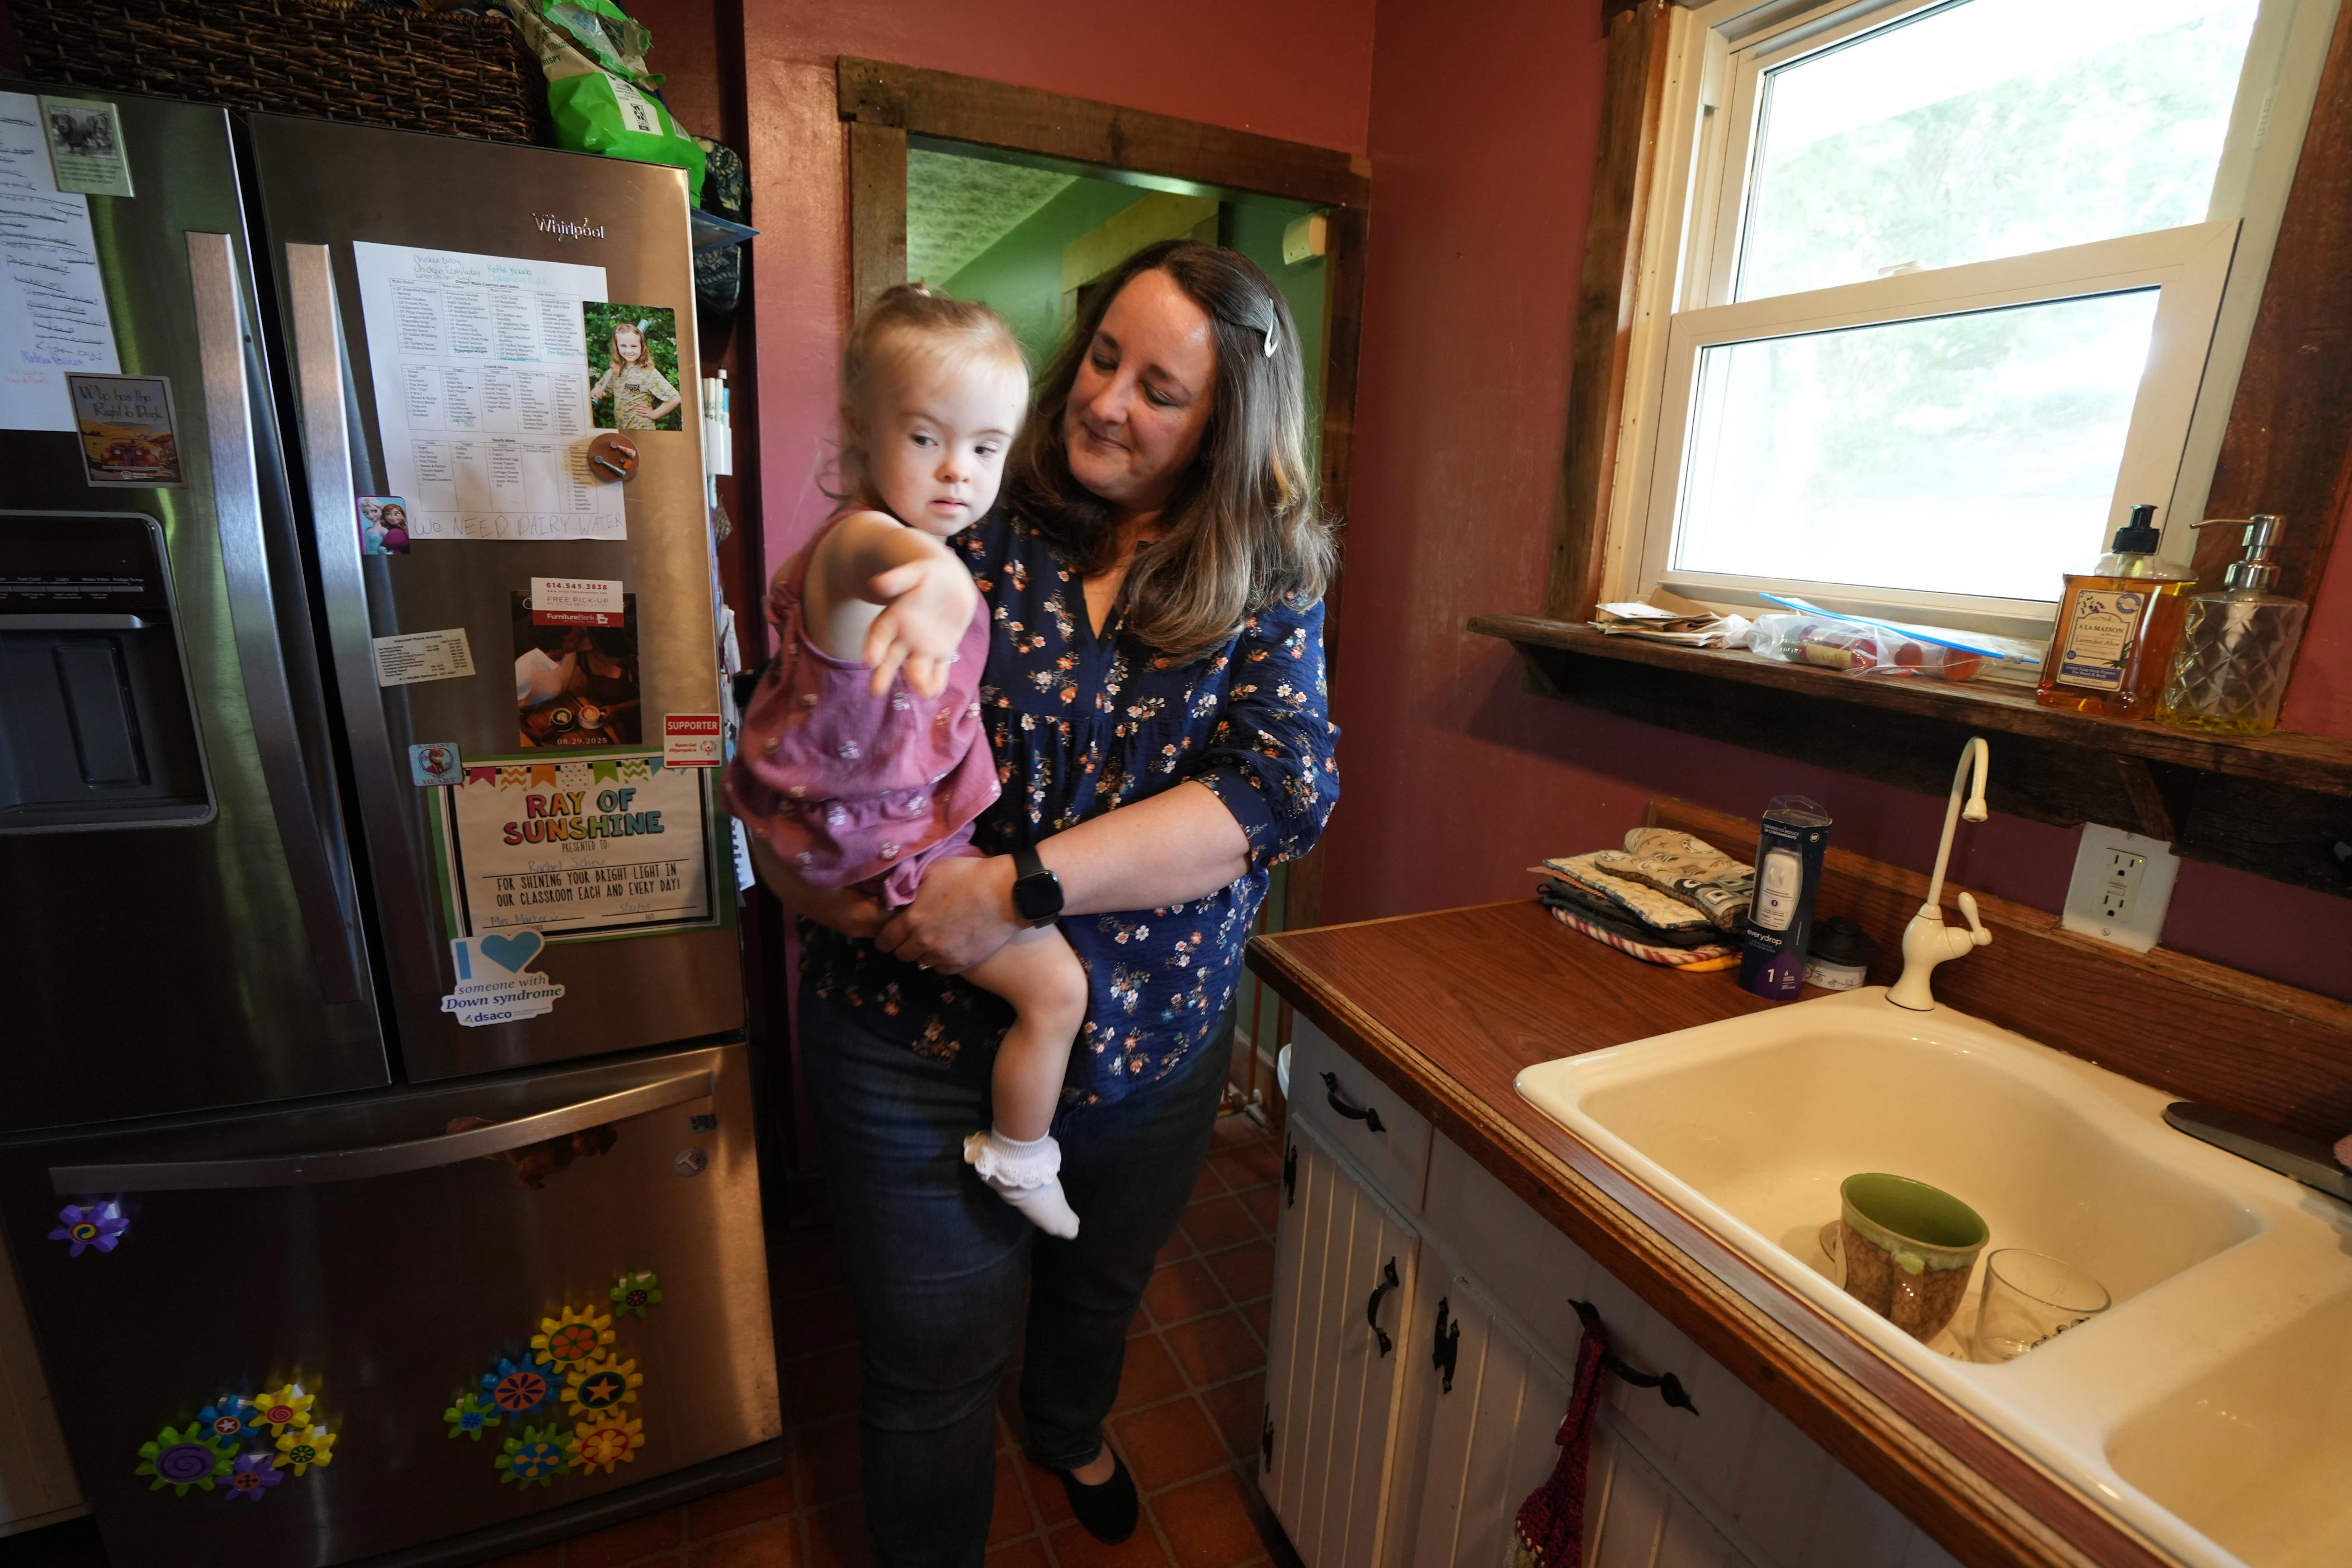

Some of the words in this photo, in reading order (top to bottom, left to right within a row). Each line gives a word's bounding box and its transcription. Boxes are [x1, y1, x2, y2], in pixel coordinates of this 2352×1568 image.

[541, 54, 561, 66] RISPY
[534, 214, 604, 241] Whirlpool
[414, 516, 442, 537] We
[453, 515, 508, 537] NEED
[518, 514, 570, 537] DAIRY
[578, 512, 625, 536] WATER
[2075, 636, 2103, 645] Lavender
[668, 721, 718, 730] SUPPORTER
[556, 737, 608, 745] 08.29.2025
[526, 791, 586, 819] RAY
[597, 787, 636, 813] OF
[503, 811, 664, 846] SUNSHINE
[562, 840, 596, 853] PRESENTED
[600, 839, 611, 850] TO:
[497, 877, 515, 891] FOR
[521, 873, 562, 889] SHINING
[567, 871, 591, 885] YOUR
[596, 867, 627, 882] BRIGHT
[633, 864, 660, 880] LIGHT
[666, 863, 677, 876] IN
[497, 894, 515, 907] OUR
[521, 888, 573, 905] CLASSROOM
[578, 885, 601, 900] EACH
[606, 883, 624, 898] AND
[629, 880, 654, 896] EVERY
[660, 877, 681, 892] DAY!
[1746, 928, 1783, 946] everydrop
[455, 941, 472, 980] I
[459, 981, 514, 995] someone
[519, 975, 546, 988] with
[1767, 969, 1775, 983] 1
[446, 996, 489, 1009] Down
[493, 987, 562, 1005] syndrome
[474, 1010, 512, 1022] dsaco
